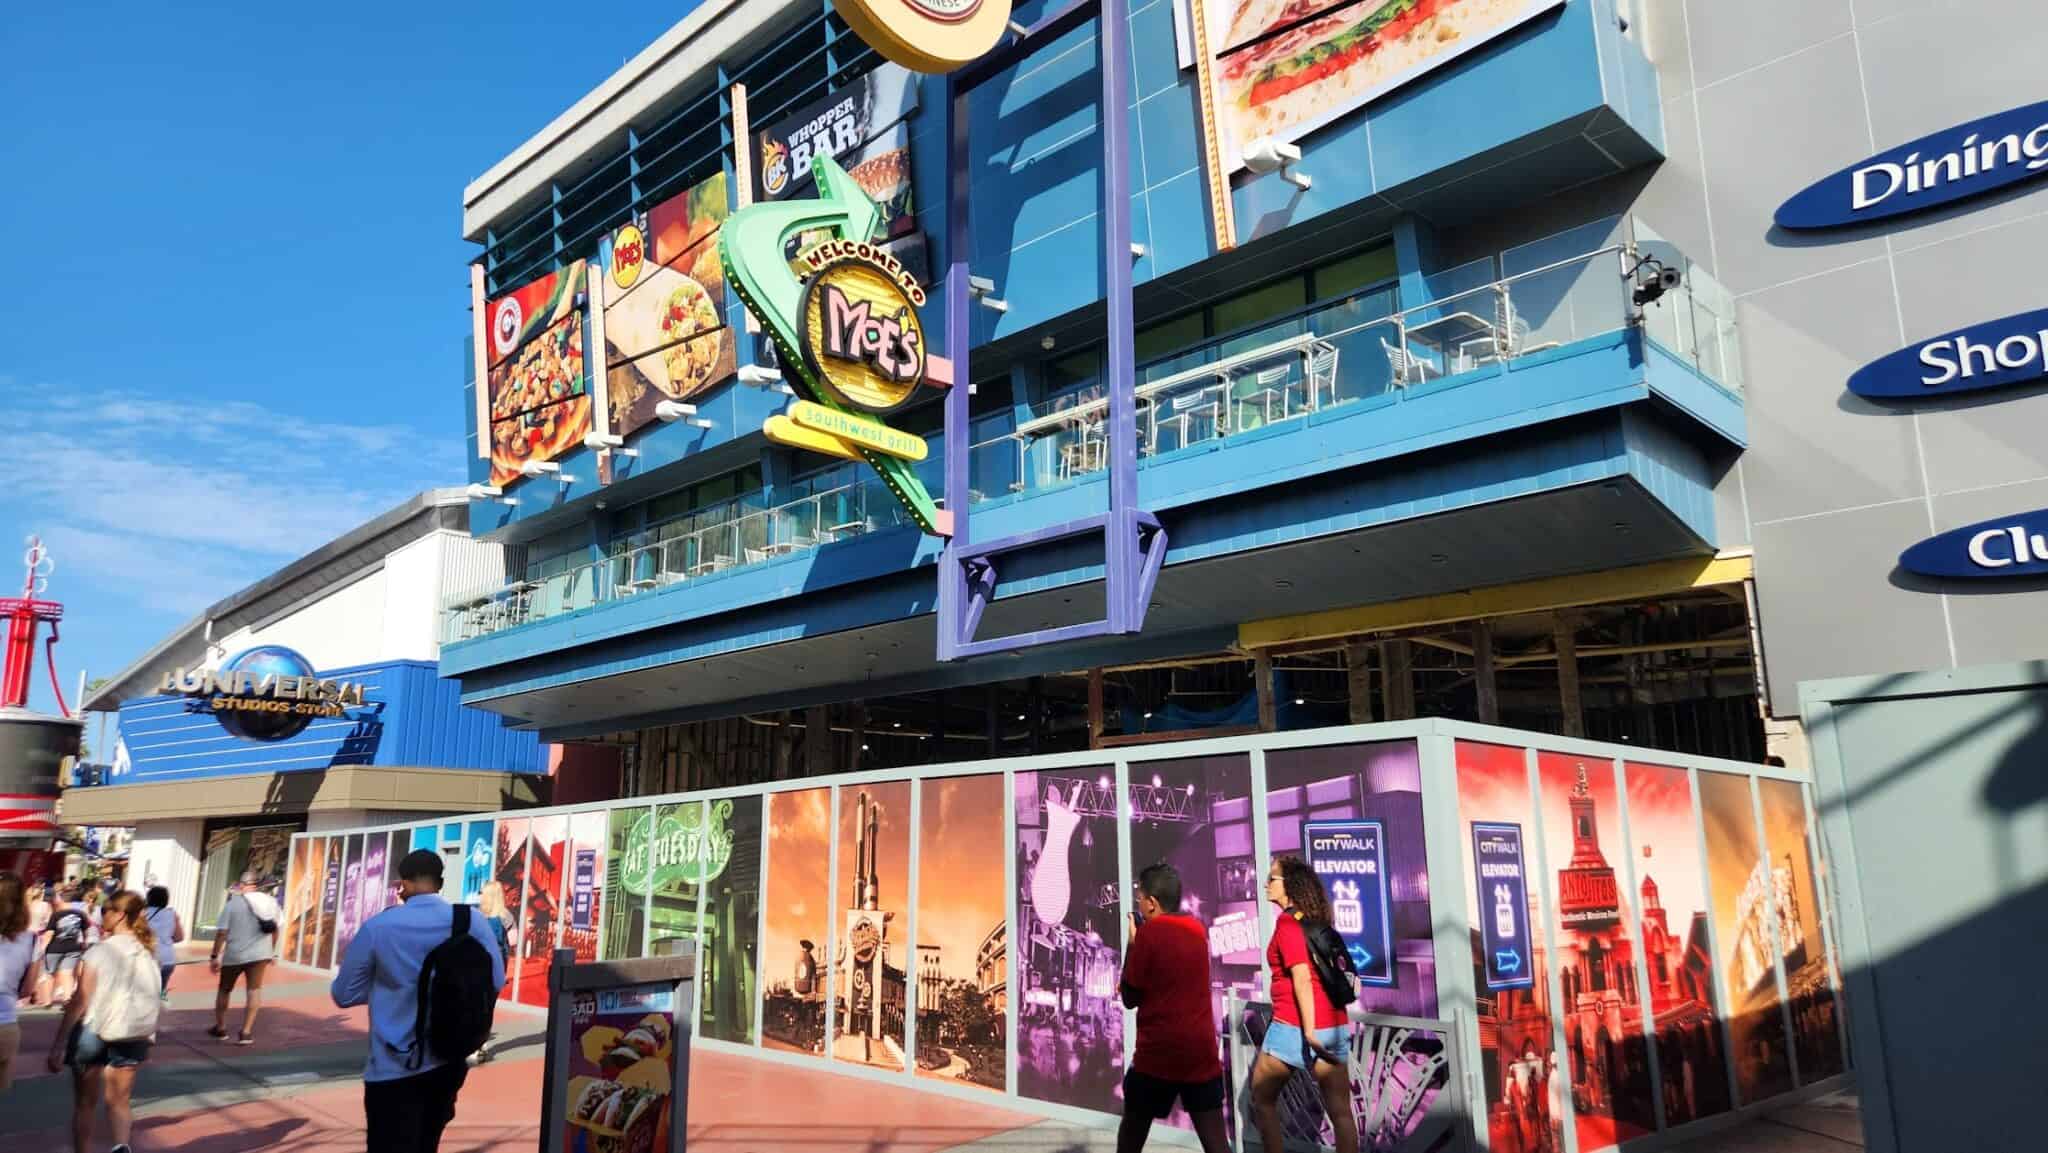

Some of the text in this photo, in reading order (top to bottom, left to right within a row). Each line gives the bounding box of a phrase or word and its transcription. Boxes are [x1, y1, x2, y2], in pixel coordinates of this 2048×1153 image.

[788, 97, 854, 148] WHOPPER
[790, 114, 858, 181] BAR
[1852, 123, 2048, 210] Dining
[768, 156, 787, 188] BK
[805, 241, 925, 304] WELCOME TO
[1919, 329, 2048, 385] Sho
[805, 408, 918, 453] southwest grill
[175, 667, 367, 705] UNIVERSAL
[211, 697, 290, 713] STUDIOS
[1313, 838, 1376, 850] CITYWALK
[1479, 841, 1517, 855] CITYWALK
[1313, 859, 1377, 874] ELEVATOR
[1481, 863, 1520, 878] ELEVATOR
